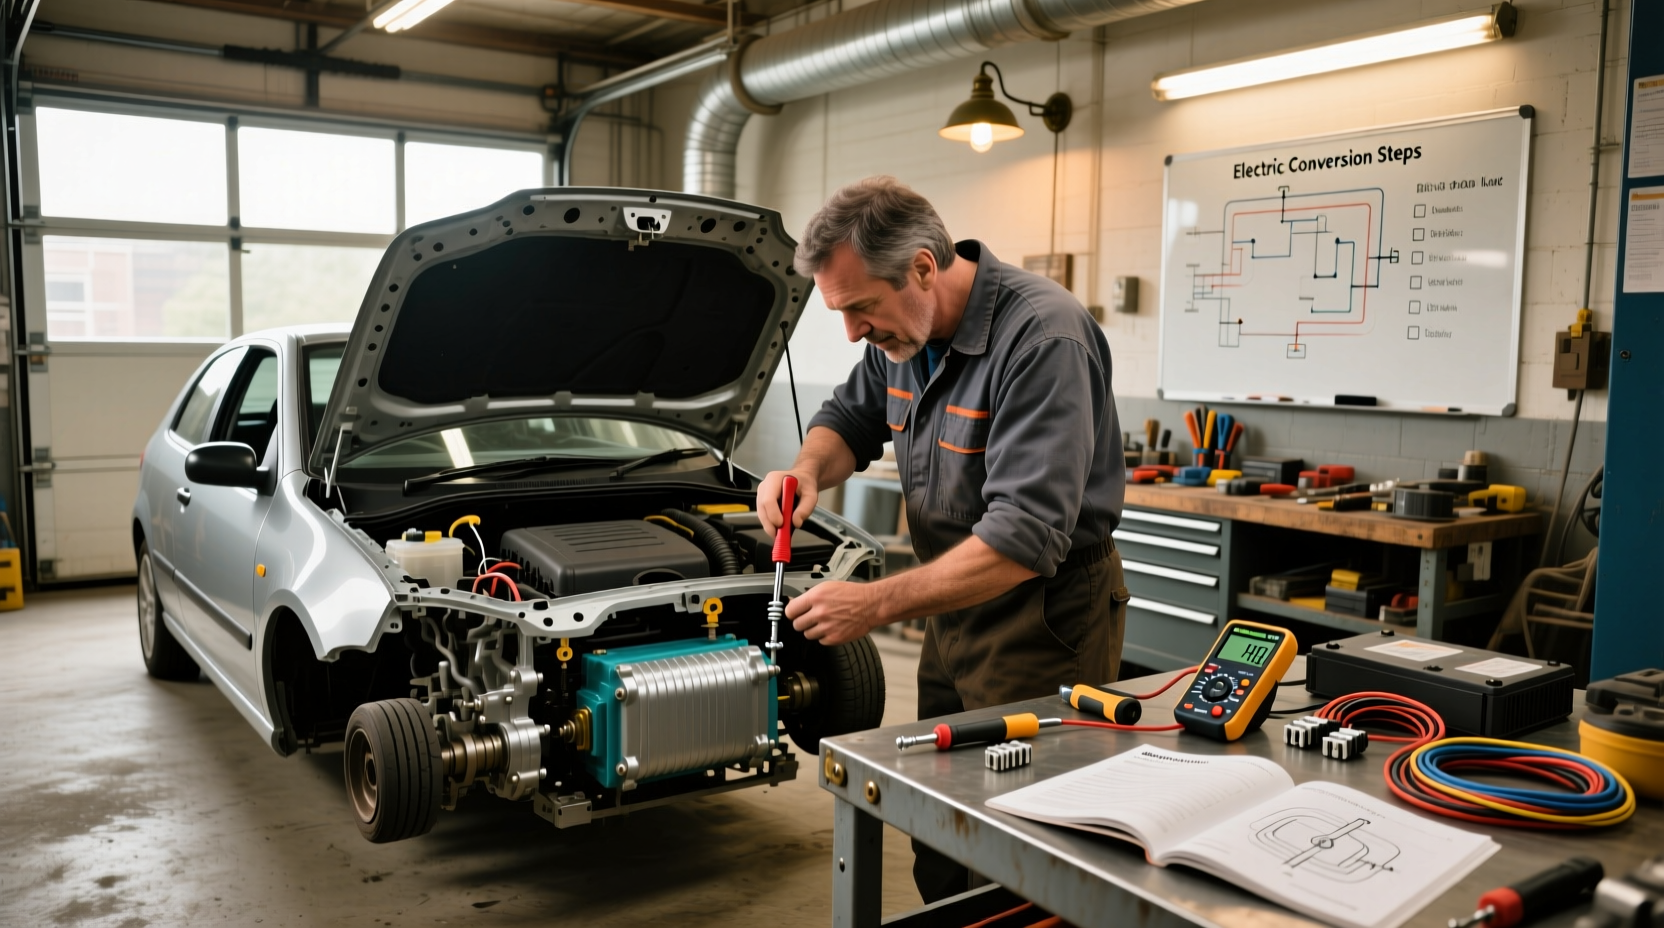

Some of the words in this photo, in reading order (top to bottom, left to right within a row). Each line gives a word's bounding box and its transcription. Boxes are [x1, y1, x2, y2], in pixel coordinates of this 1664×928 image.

[1233, 157, 1285, 179] Electric
[1288, 148, 1373, 173] Conversion
[1377, 145, 1422, 165] Steps
